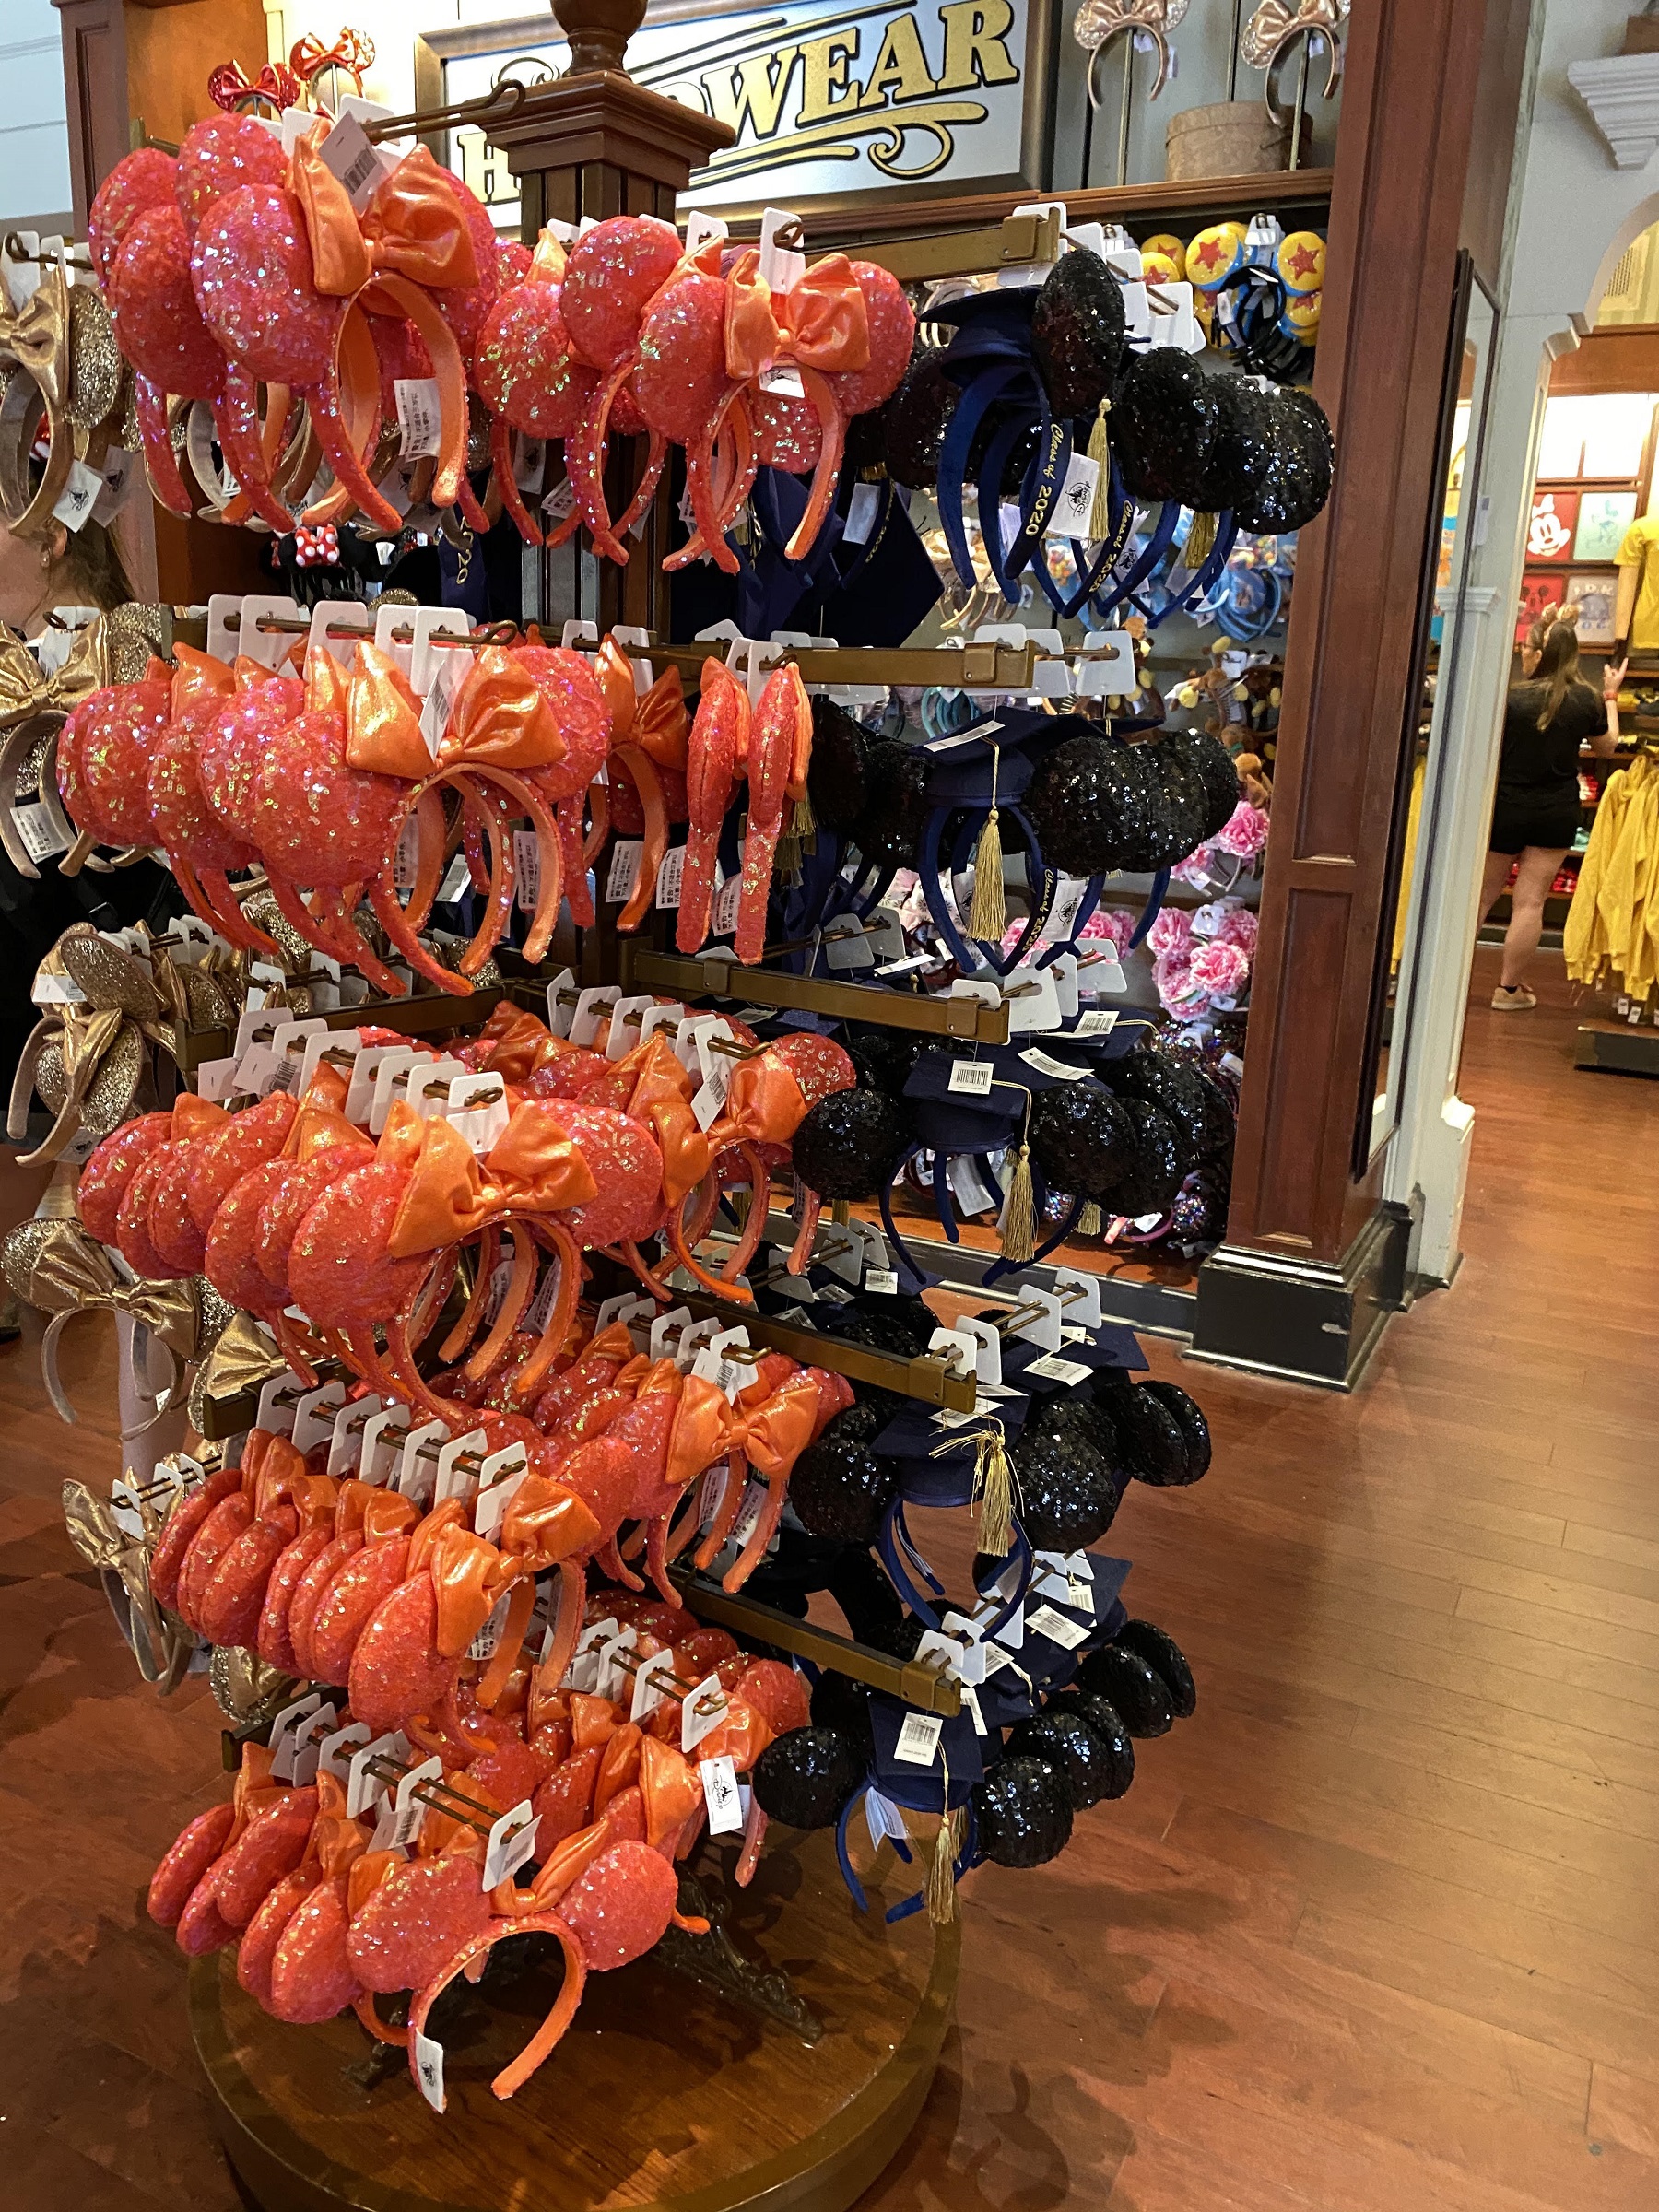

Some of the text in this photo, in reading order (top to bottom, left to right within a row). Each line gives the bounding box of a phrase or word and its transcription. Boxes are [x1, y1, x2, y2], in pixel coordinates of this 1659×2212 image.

[457, 0, 1019, 203] HWEAR
[1026, 423, 1064, 536] Class of 2020
[1118, 500, 1133, 535] Class
[1112, 535, 1122, 548] of
[1088, 553, 1116, 593] 2020
[1043, 868, 1054, 900] Class
[1021, 916, 1046, 952] 2020
